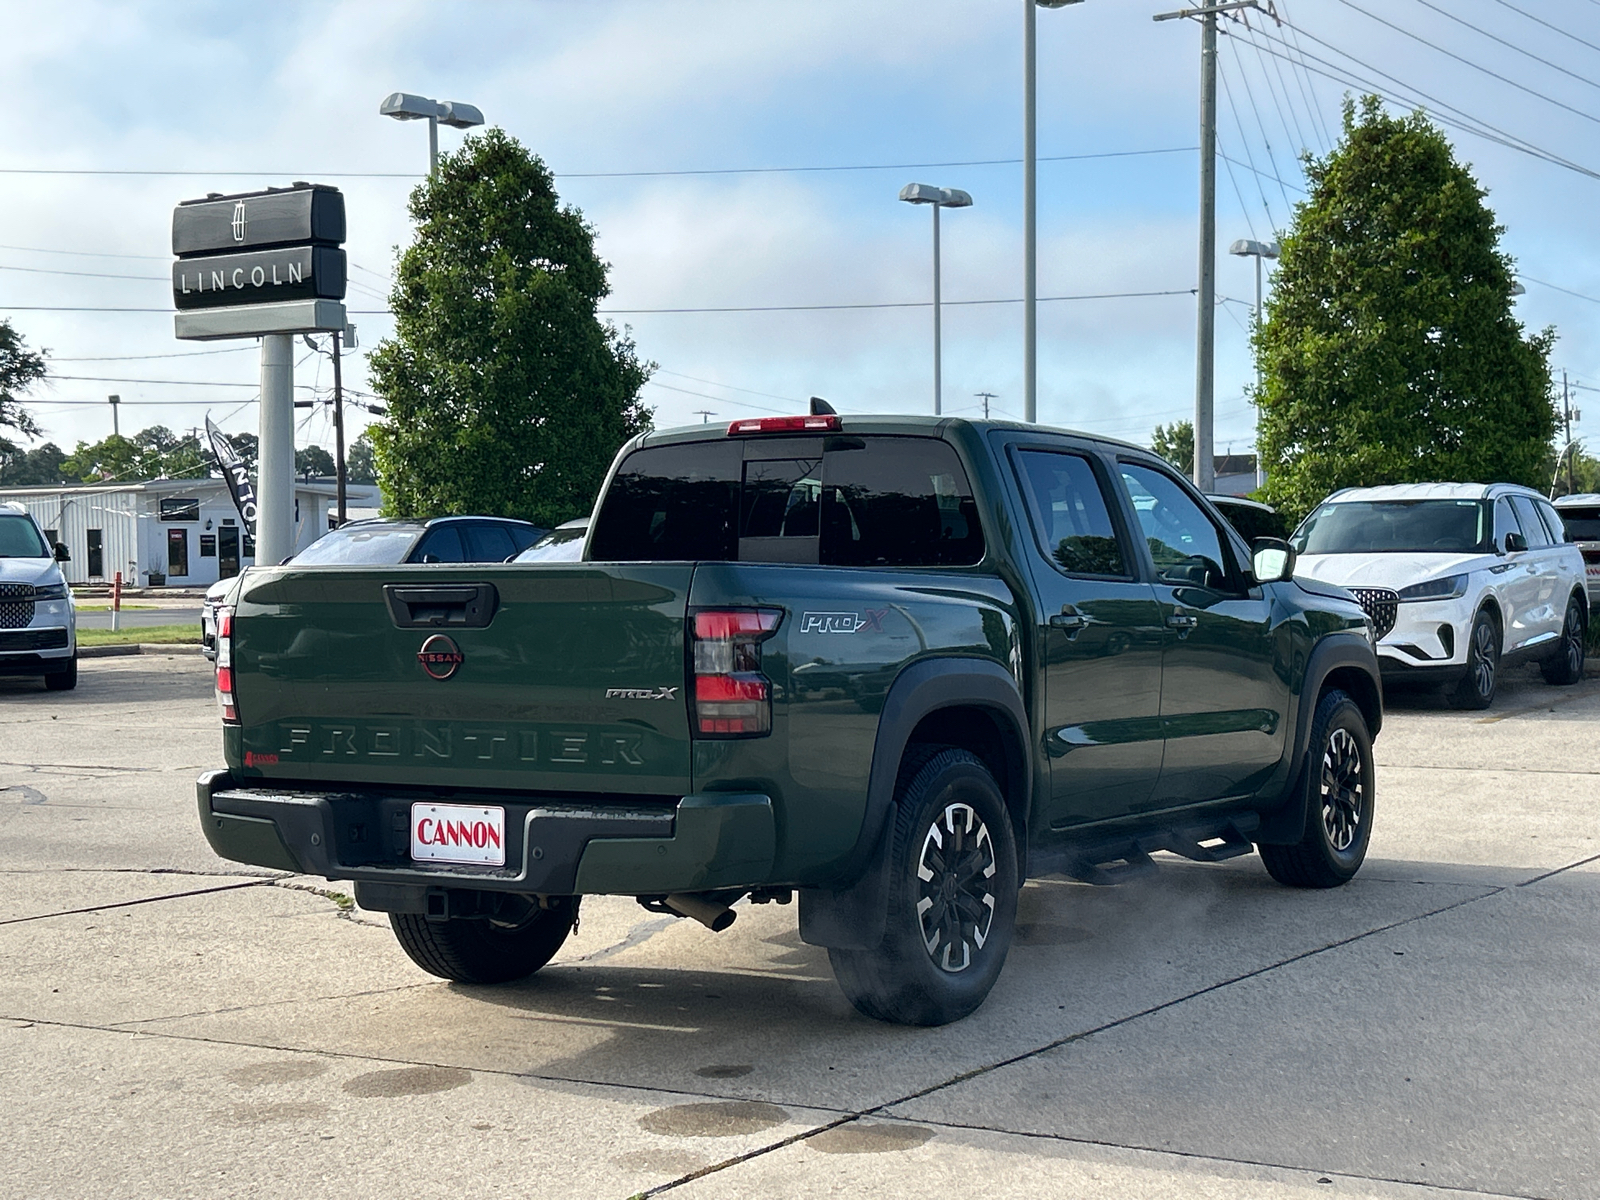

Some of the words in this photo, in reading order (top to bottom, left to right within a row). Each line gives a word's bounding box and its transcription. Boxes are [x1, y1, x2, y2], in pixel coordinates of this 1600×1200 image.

[181, 262, 303, 294] LINCOLN
[417, 653, 463, 663] NISSAN
[605, 686, 679, 700] PRO-X
[279, 723, 645, 765] FRONTIER
[417, 818, 500, 849] CANNON
